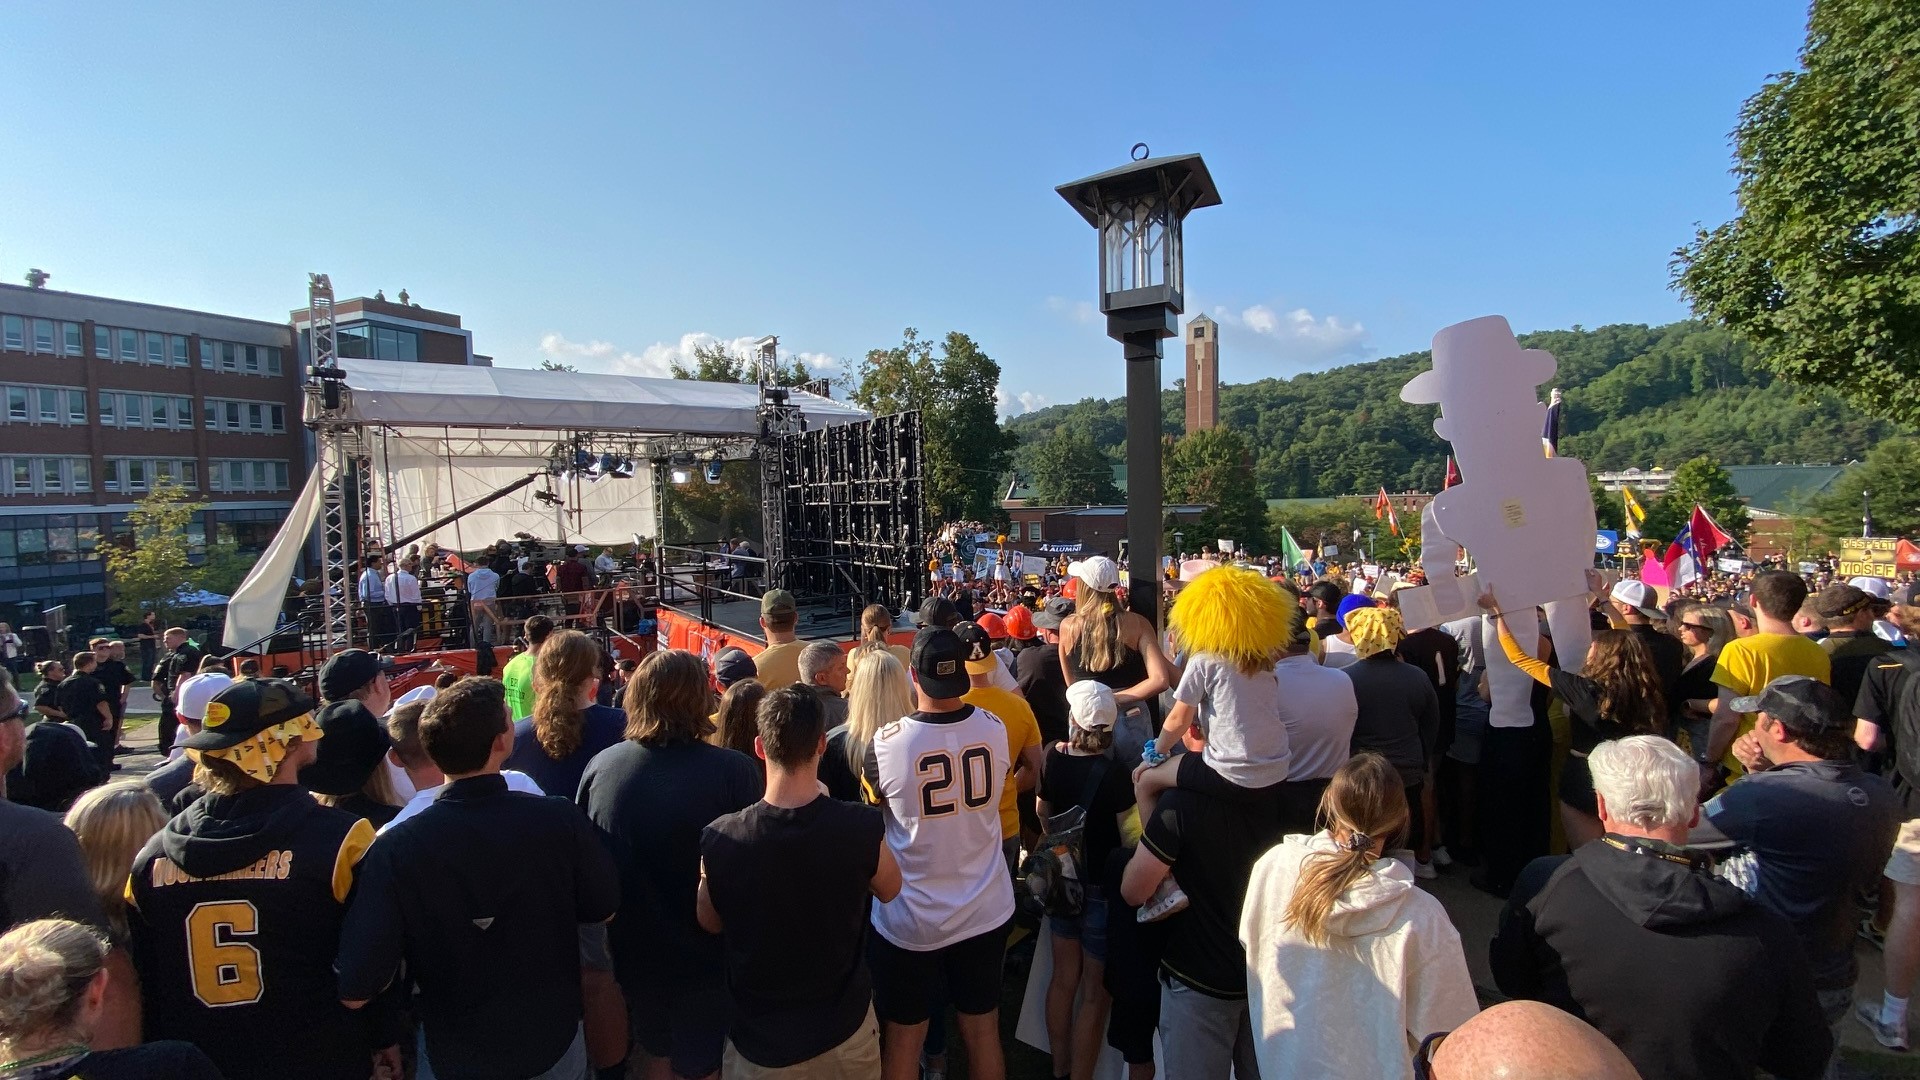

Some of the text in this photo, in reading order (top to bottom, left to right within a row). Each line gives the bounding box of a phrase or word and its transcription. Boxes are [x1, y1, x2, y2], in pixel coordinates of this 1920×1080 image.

[1842, 540, 1895, 549] RESPECT
[1843, 563, 1894, 576] YOSEF
[969, 641, 985, 660] A
[915, 743, 994, 820] 20
[185, 900, 265, 1009] 6
